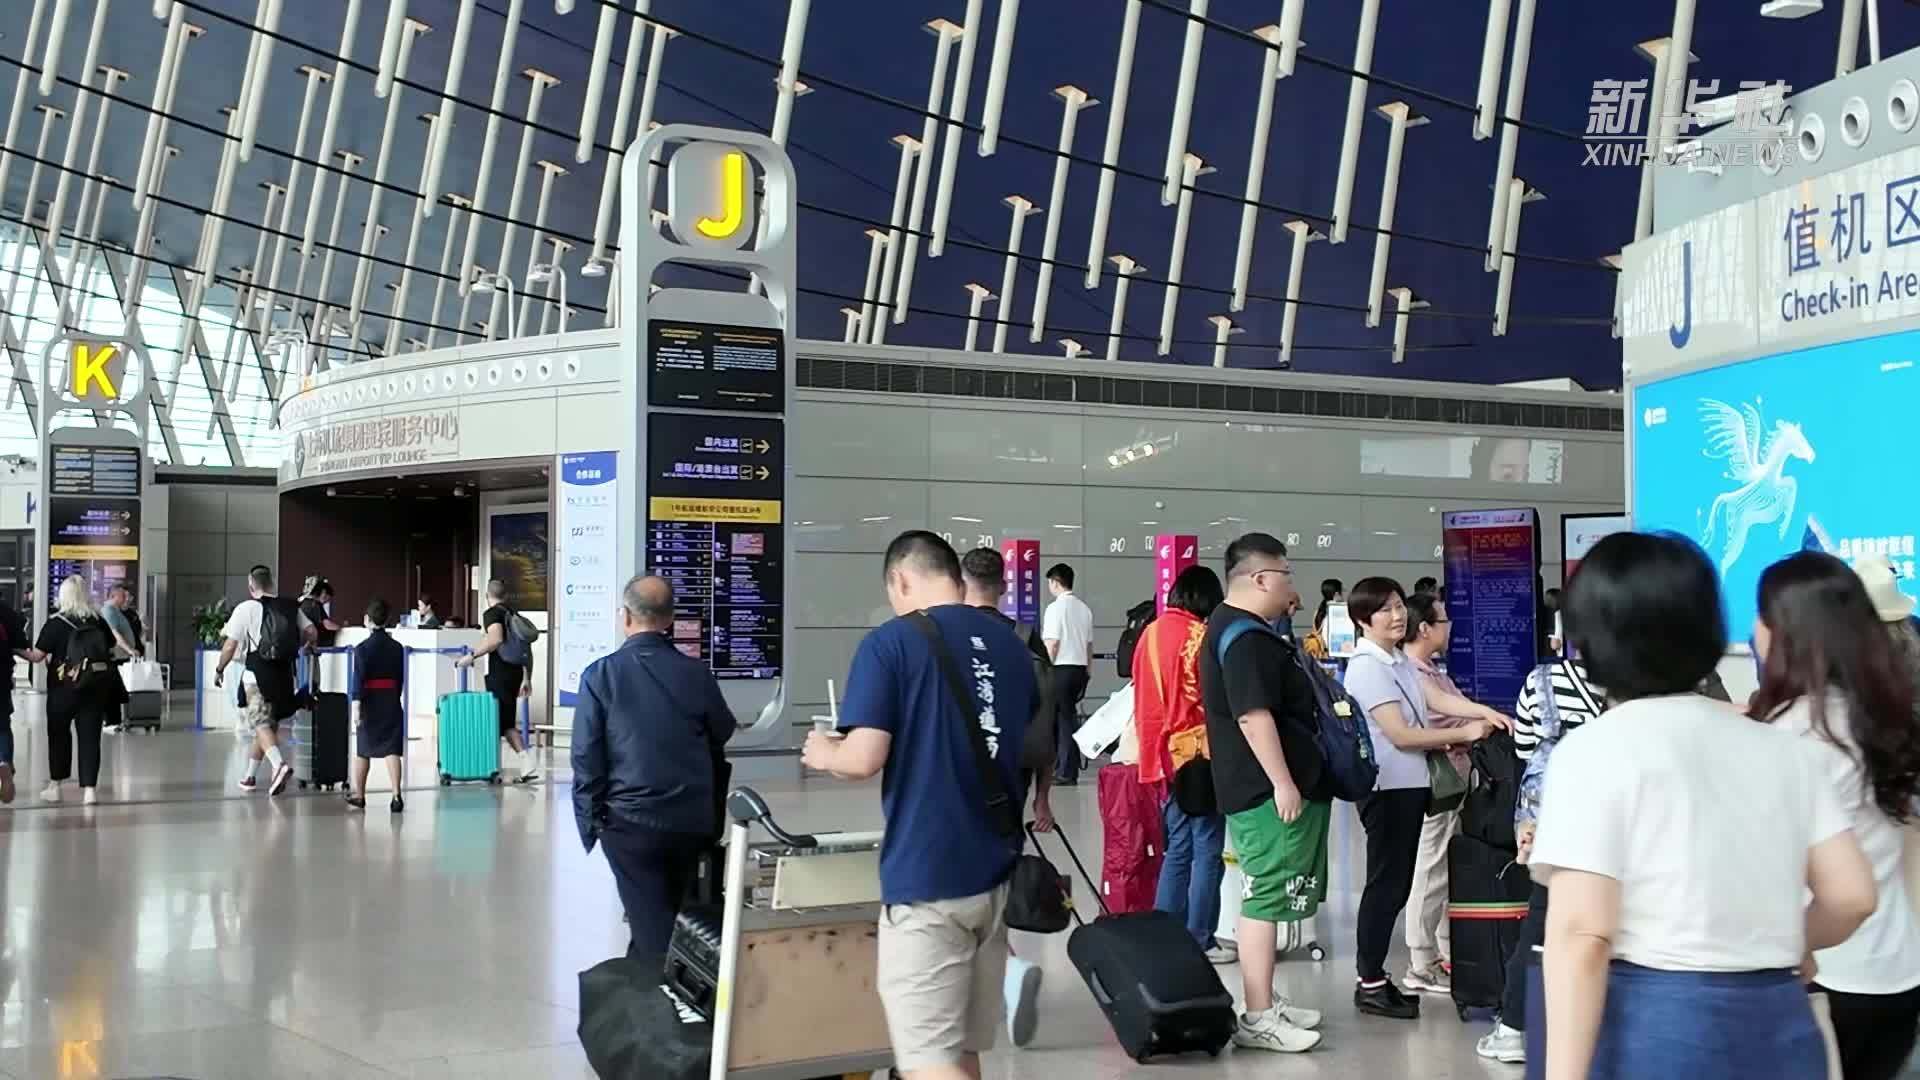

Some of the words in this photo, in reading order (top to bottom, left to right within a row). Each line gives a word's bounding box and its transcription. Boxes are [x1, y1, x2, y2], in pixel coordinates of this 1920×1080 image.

[696, 152, 742, 238] J
[1783, 174, 1920, 278] 值机区
[1669, 241, 1692, 349] J
[1781, 275, 1869, 322] Check-in
[1877, 270, 1920, 303] Are
[74, 343, 118, 398] K
